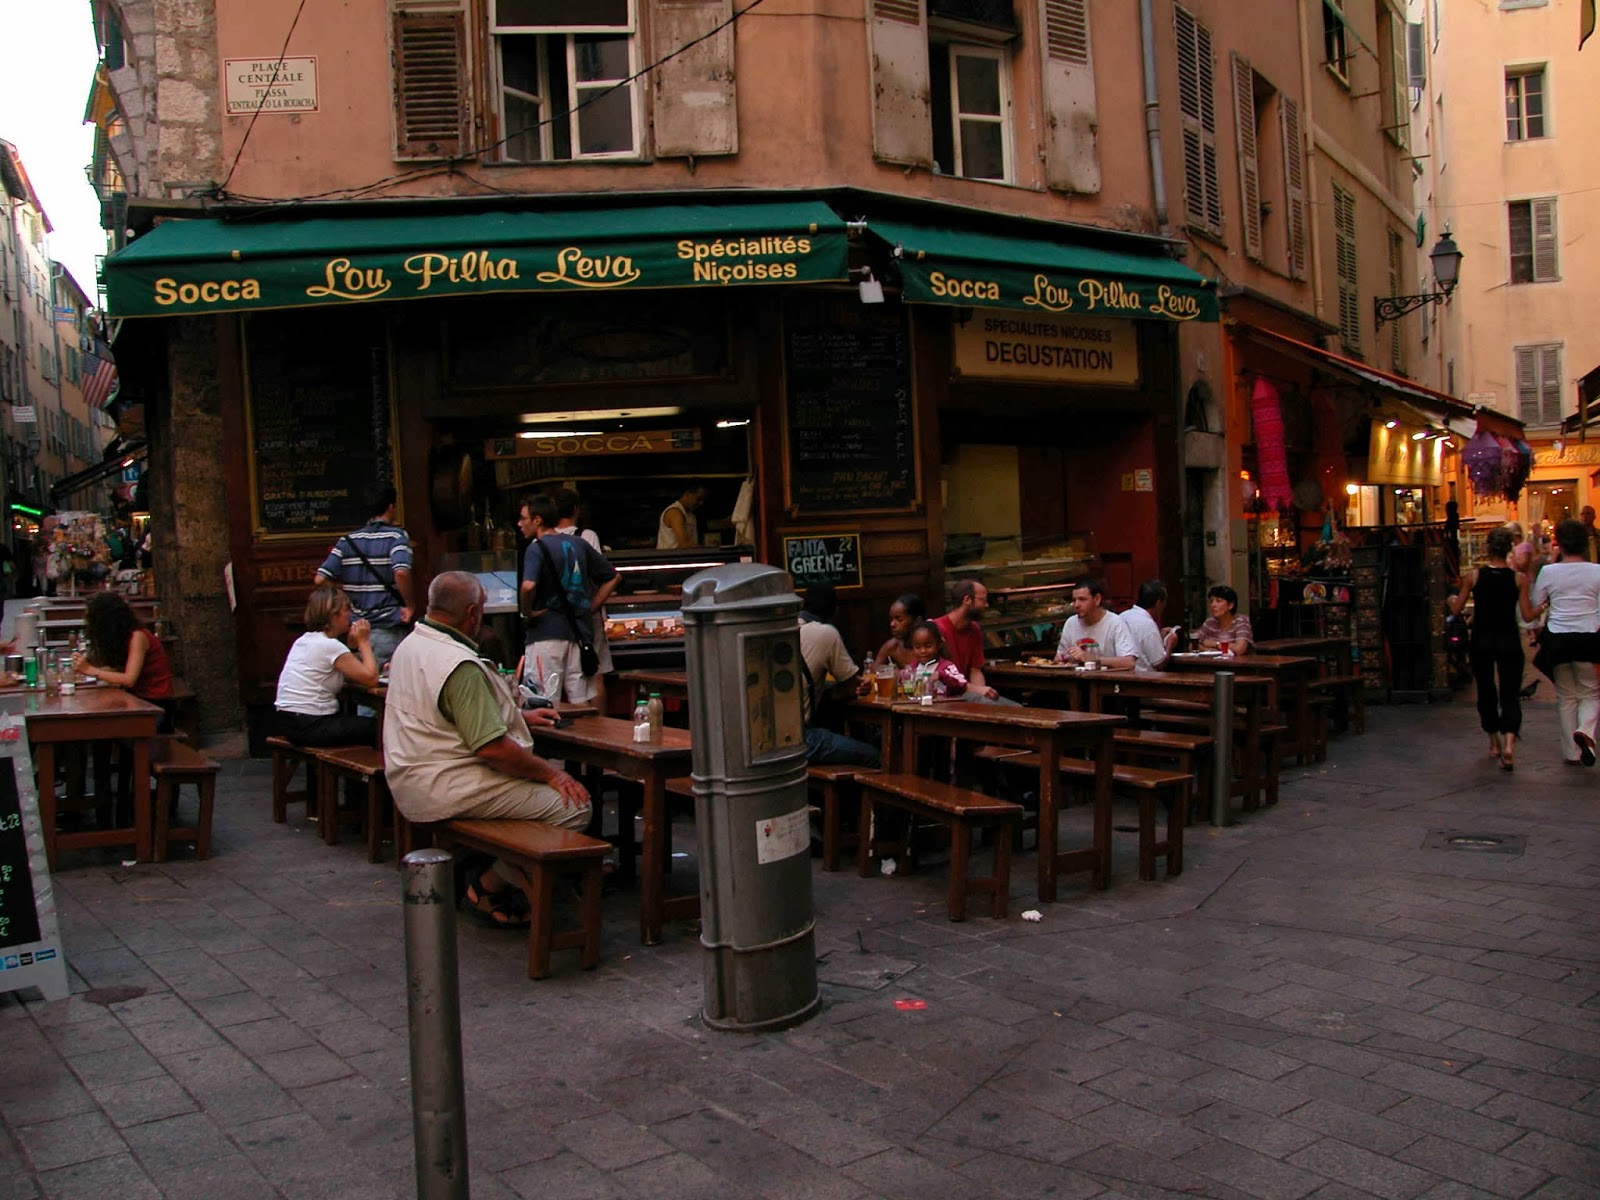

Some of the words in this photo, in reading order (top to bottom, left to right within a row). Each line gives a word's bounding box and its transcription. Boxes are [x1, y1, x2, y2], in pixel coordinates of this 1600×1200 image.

[238, 73, 304, 84] CENTRALE
[252, 62, 289, 73] PLACE
[255, 88, 288, 98] PLASSA
[677, 235, 812, 262] Spécialités
[155, 277, 261, 305] Socca
[306, 257, 392, 300] Lou
[404, 250, 520, 290] Pilha
[537, 246, 641, 289] Leva
[693, 260, 798, 284] Niçoises
[929, 271, 1000, 300] Socca
[1022, 274, 1073, 311] Lou
[1077, 278, 1142, 310] Pilha
[1149, 284, 1201, 320] Leva
[984, 318, 1059, 338] SPECIALITES
[985, 340, 1113, 371] DEGUSTATION
[535, 435, 653, 455] SOCCA
